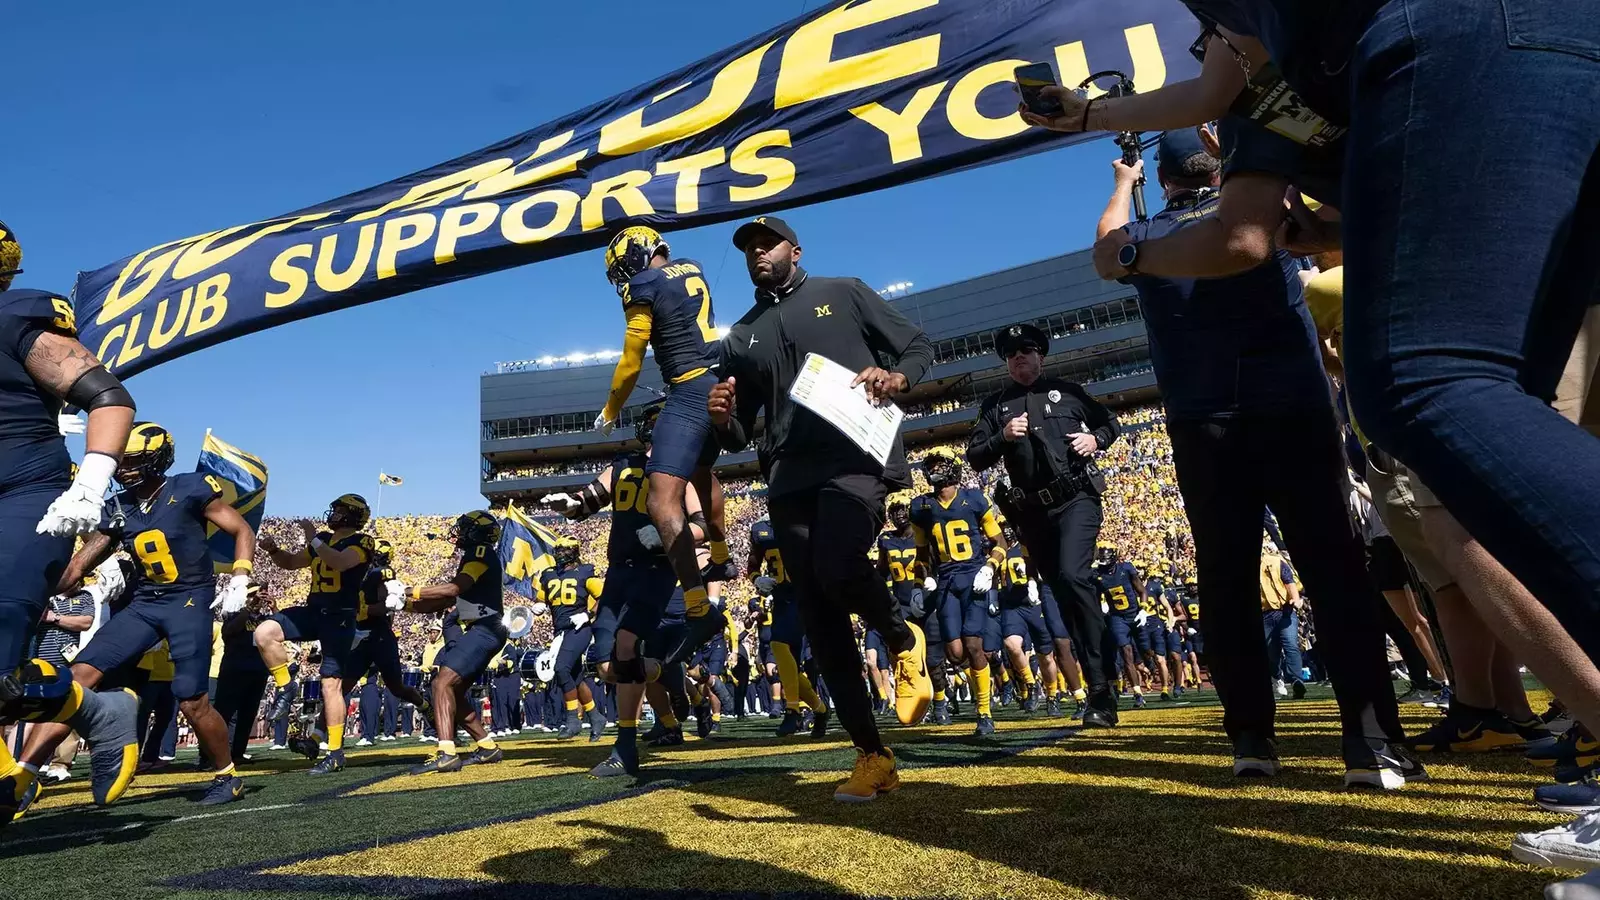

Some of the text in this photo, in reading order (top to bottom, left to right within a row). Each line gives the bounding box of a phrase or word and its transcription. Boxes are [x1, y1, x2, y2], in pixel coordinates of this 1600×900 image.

[96, 23, 1167, 371] CLUB SUPPORTS YOU
[685, 276, 720, 343] 2
[815, 304, 832, 318] M
[204, 474, 222, 493] 8
[932, 519, 973, 562] 16
[133, 529, 179, 584] 8
[547, 578, 578, 606] 26
[1108, 585, 1130, 611] 5
[541, 660, 550, 671] M
